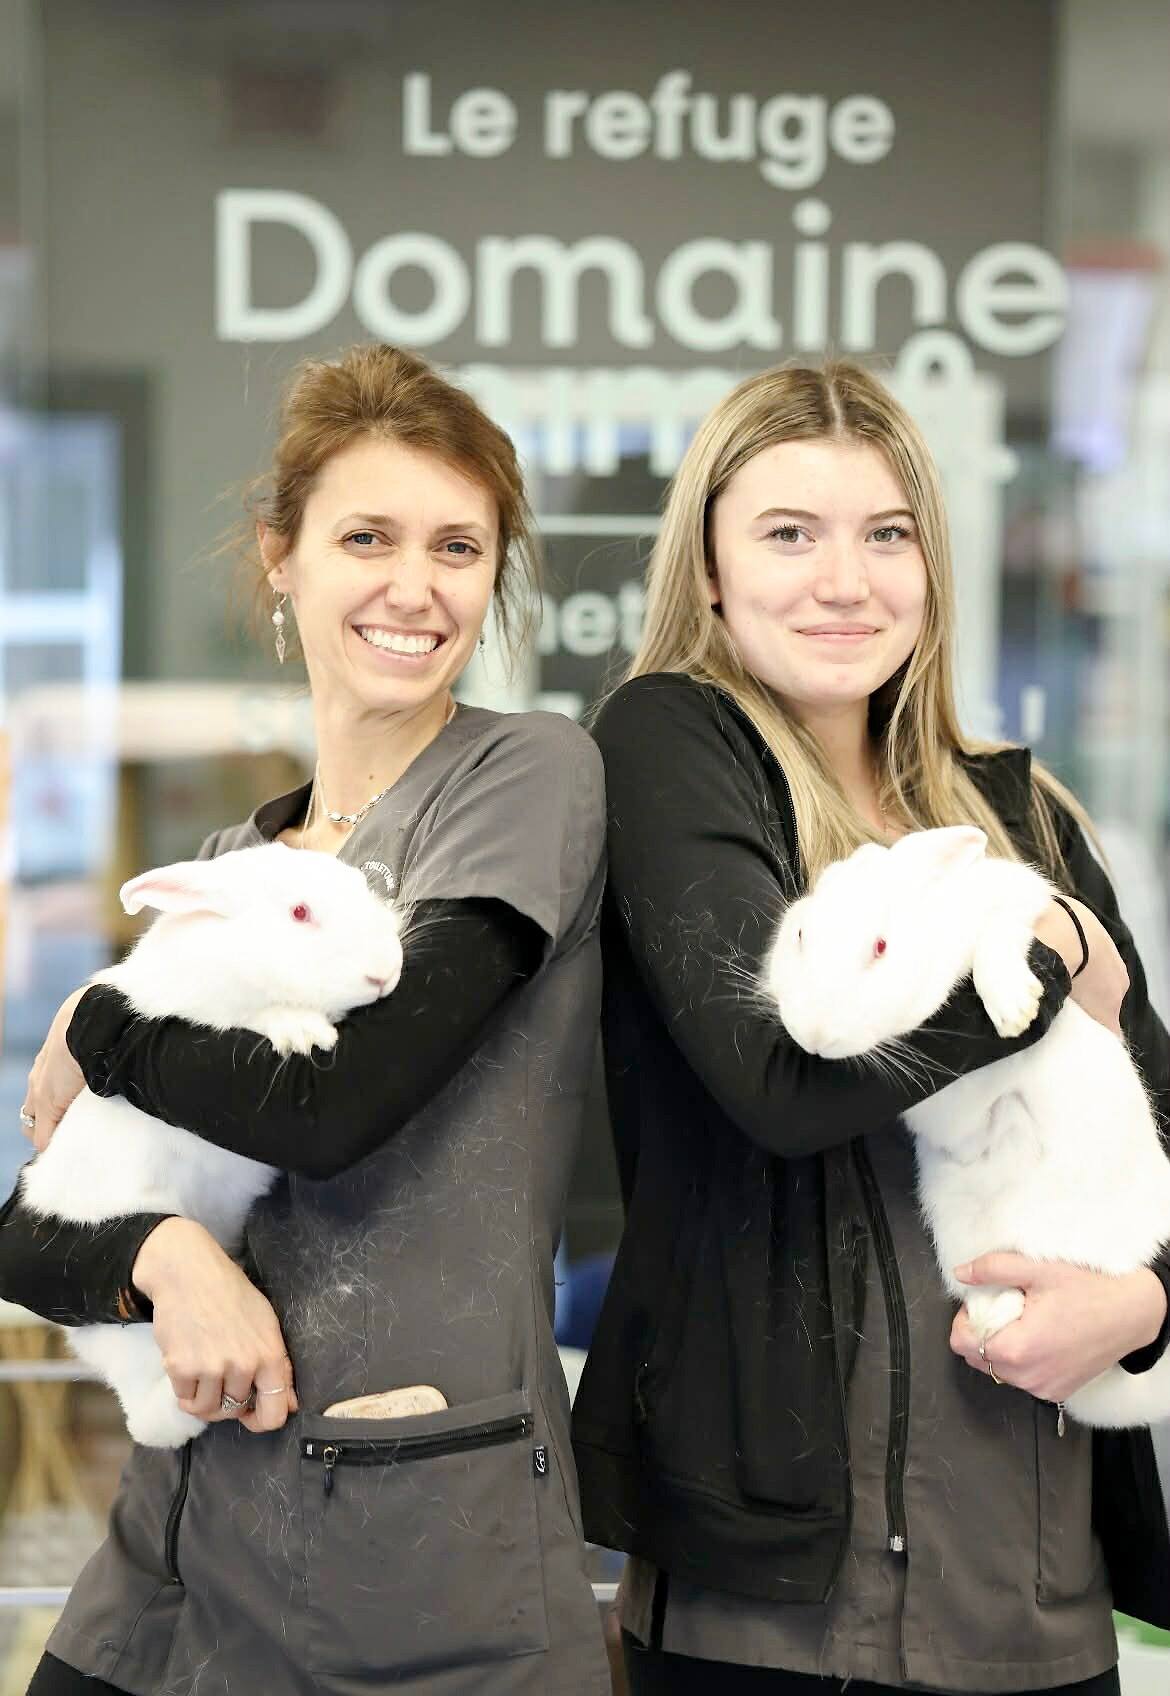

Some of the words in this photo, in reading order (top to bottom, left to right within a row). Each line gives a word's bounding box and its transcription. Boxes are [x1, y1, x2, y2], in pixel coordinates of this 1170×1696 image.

[403, 74, 517, 158] Le
[544, 72, 895, 189] refuge
[215, 189, 1070, 356] Domaine
